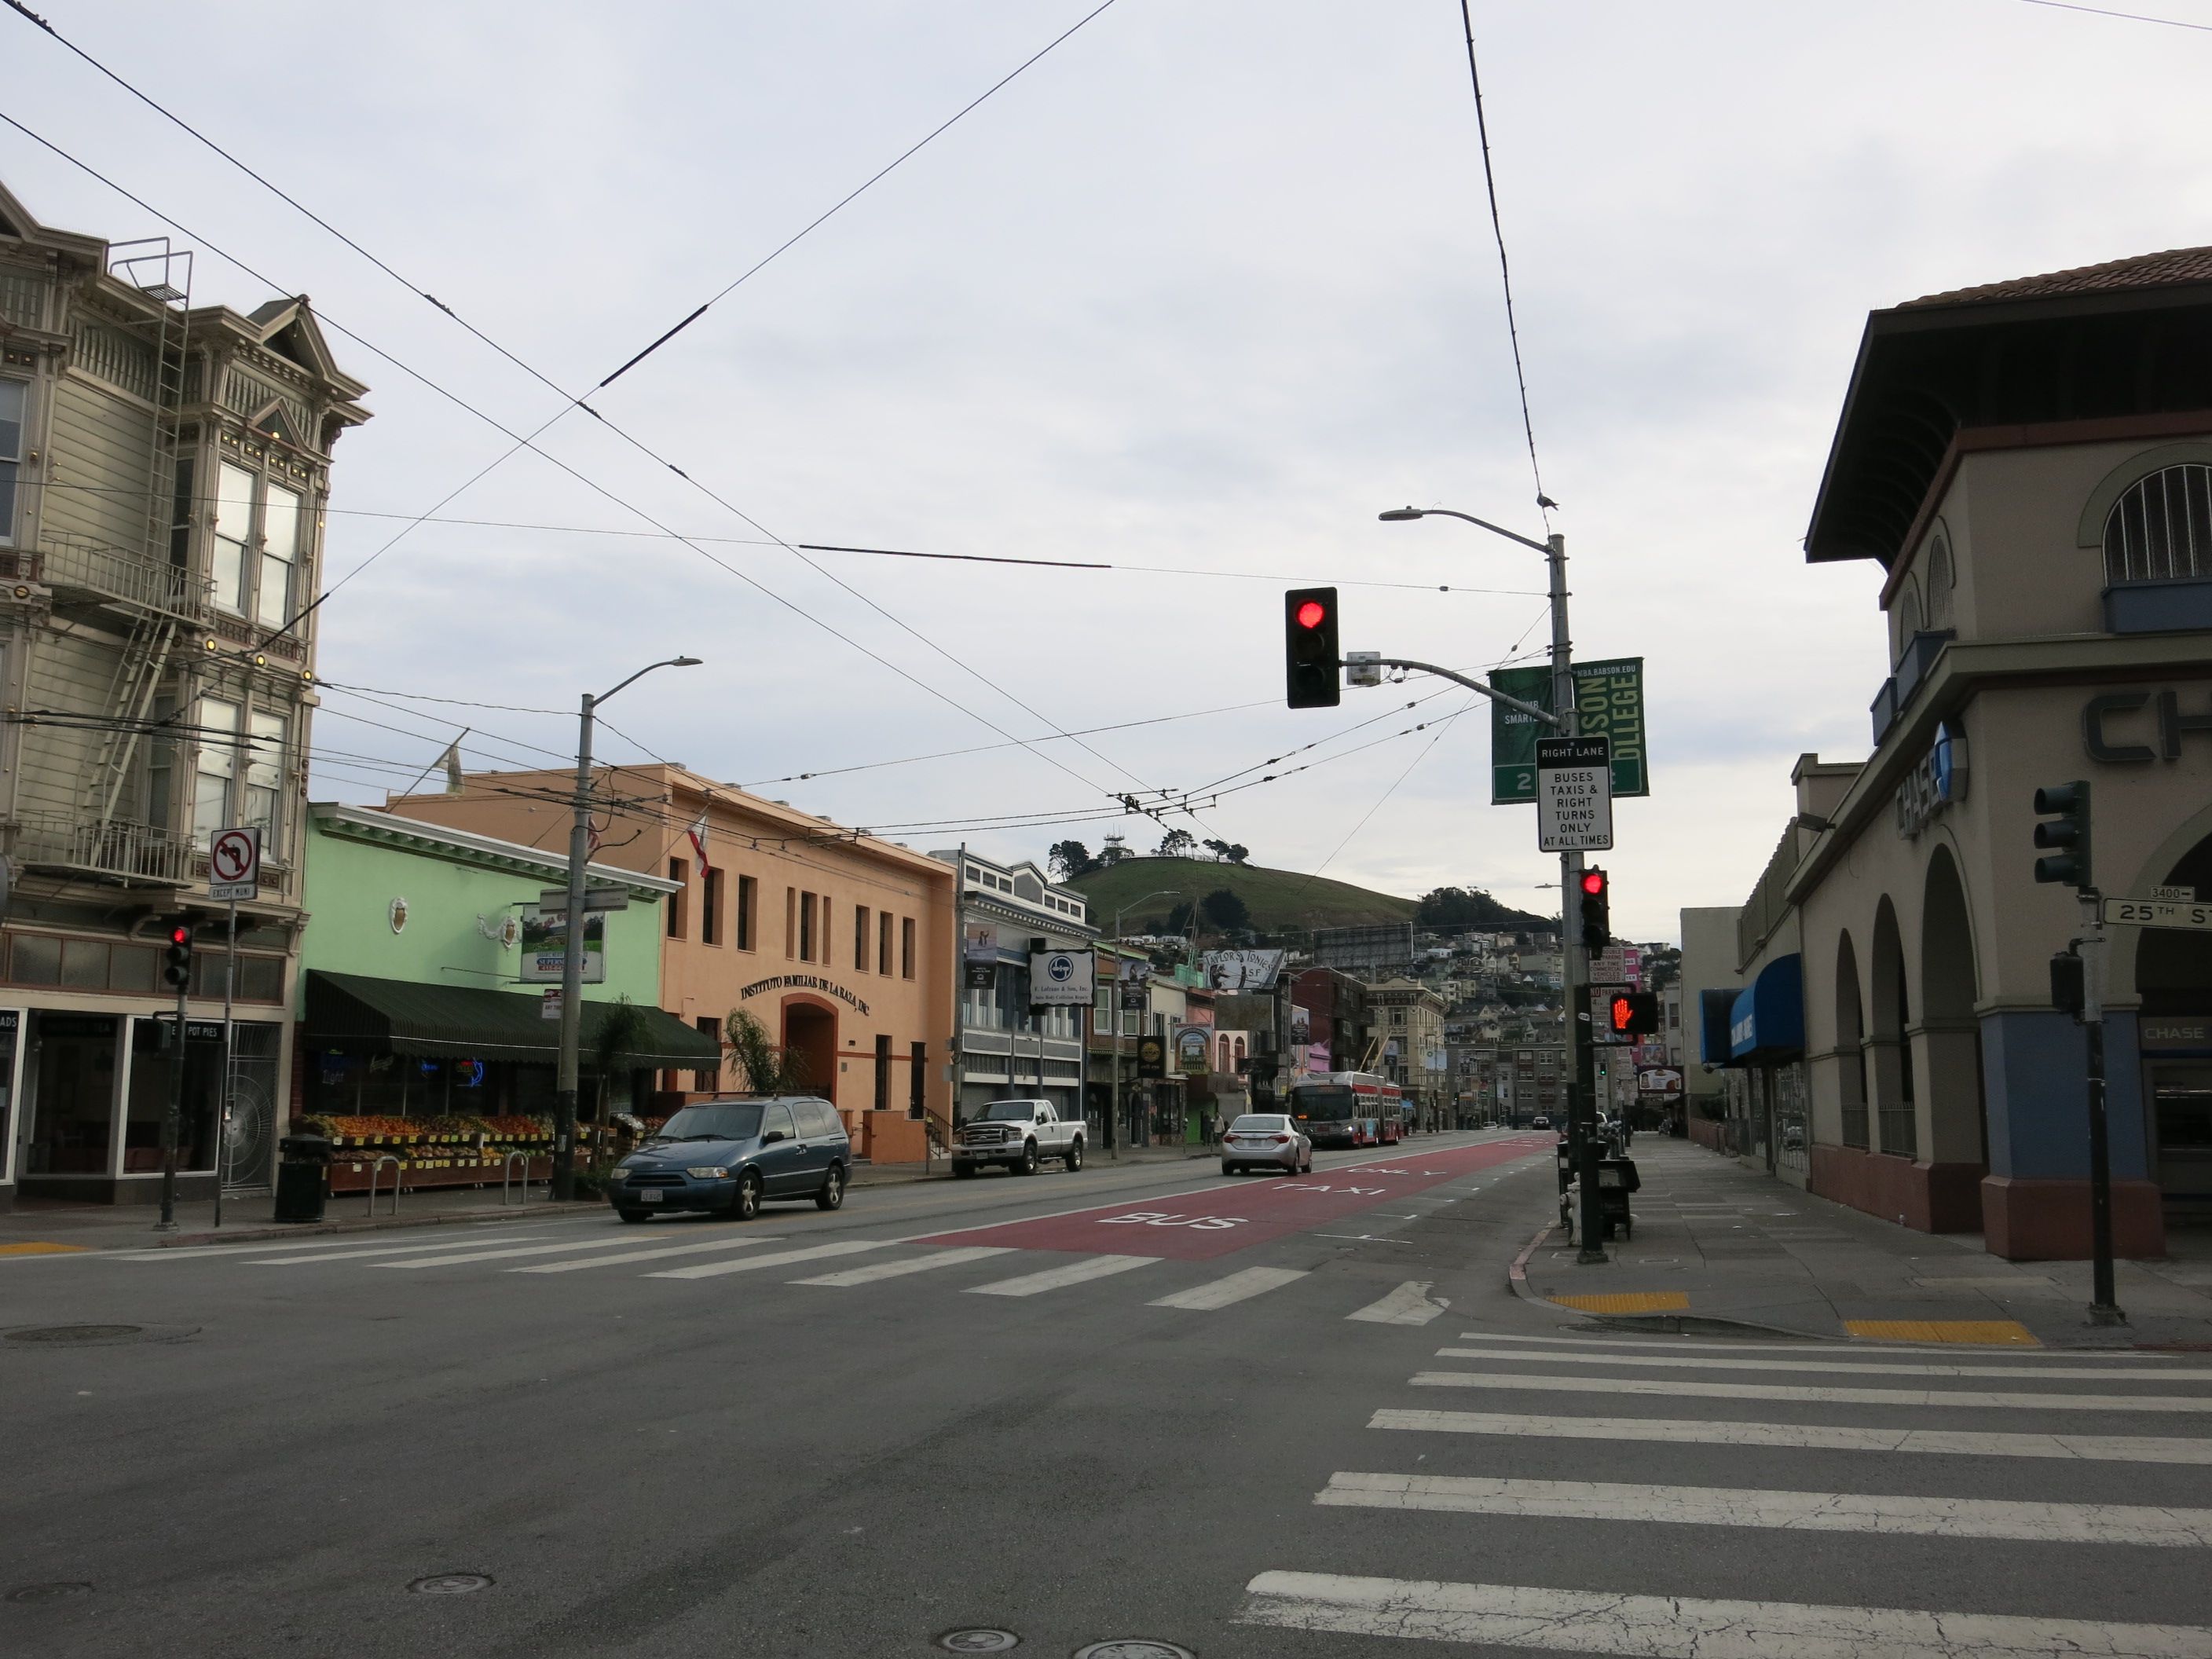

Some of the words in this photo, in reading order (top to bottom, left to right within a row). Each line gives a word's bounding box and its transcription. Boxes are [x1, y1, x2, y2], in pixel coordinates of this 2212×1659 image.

[1577, 665, 1635, 677] MBA.BABSON.EDU
[1542, 748, 1572, 758] RIGHT
[1577, 747, 1604, 757] LANE
[1555, 772, 1593, 783] BUSES
[1551, 785, 1584, 796] TAXIS
[1589, 785, 1598, 794] &
[1895, 746, 1941, 840] CHASE
[1557, 797, 1592, 808] RIGHT
[1555, 810, 1595, 821] TURNS
[1560, 822, 1591, 833] ONLY
[1544, 837, 1555, 847] AT
[1558, 836, 1576, 846] ALL
[1580, 835, 1609, 845] TIMES
[2152, 888, 2180, 898] 3400
[2120, 905, 2174, 921] 25TH
[741, 976, 782, 1000] INSTITUTO
[783, 975, 818, 987] FAMILIAR
[819, 978, 829, 992] DE
[829, 982, 838, 997] LA
[1591, 987, 1601, 997] NO
[188, 1026, 200, 1035] POT
[203, 1027, 218, 1037] PIES
[2144, 1027, 2205, 1038] CHASE
[1272, 1183, 1386, 1195] TAXI
[1094, 1212, 1249, 1229] BUS
